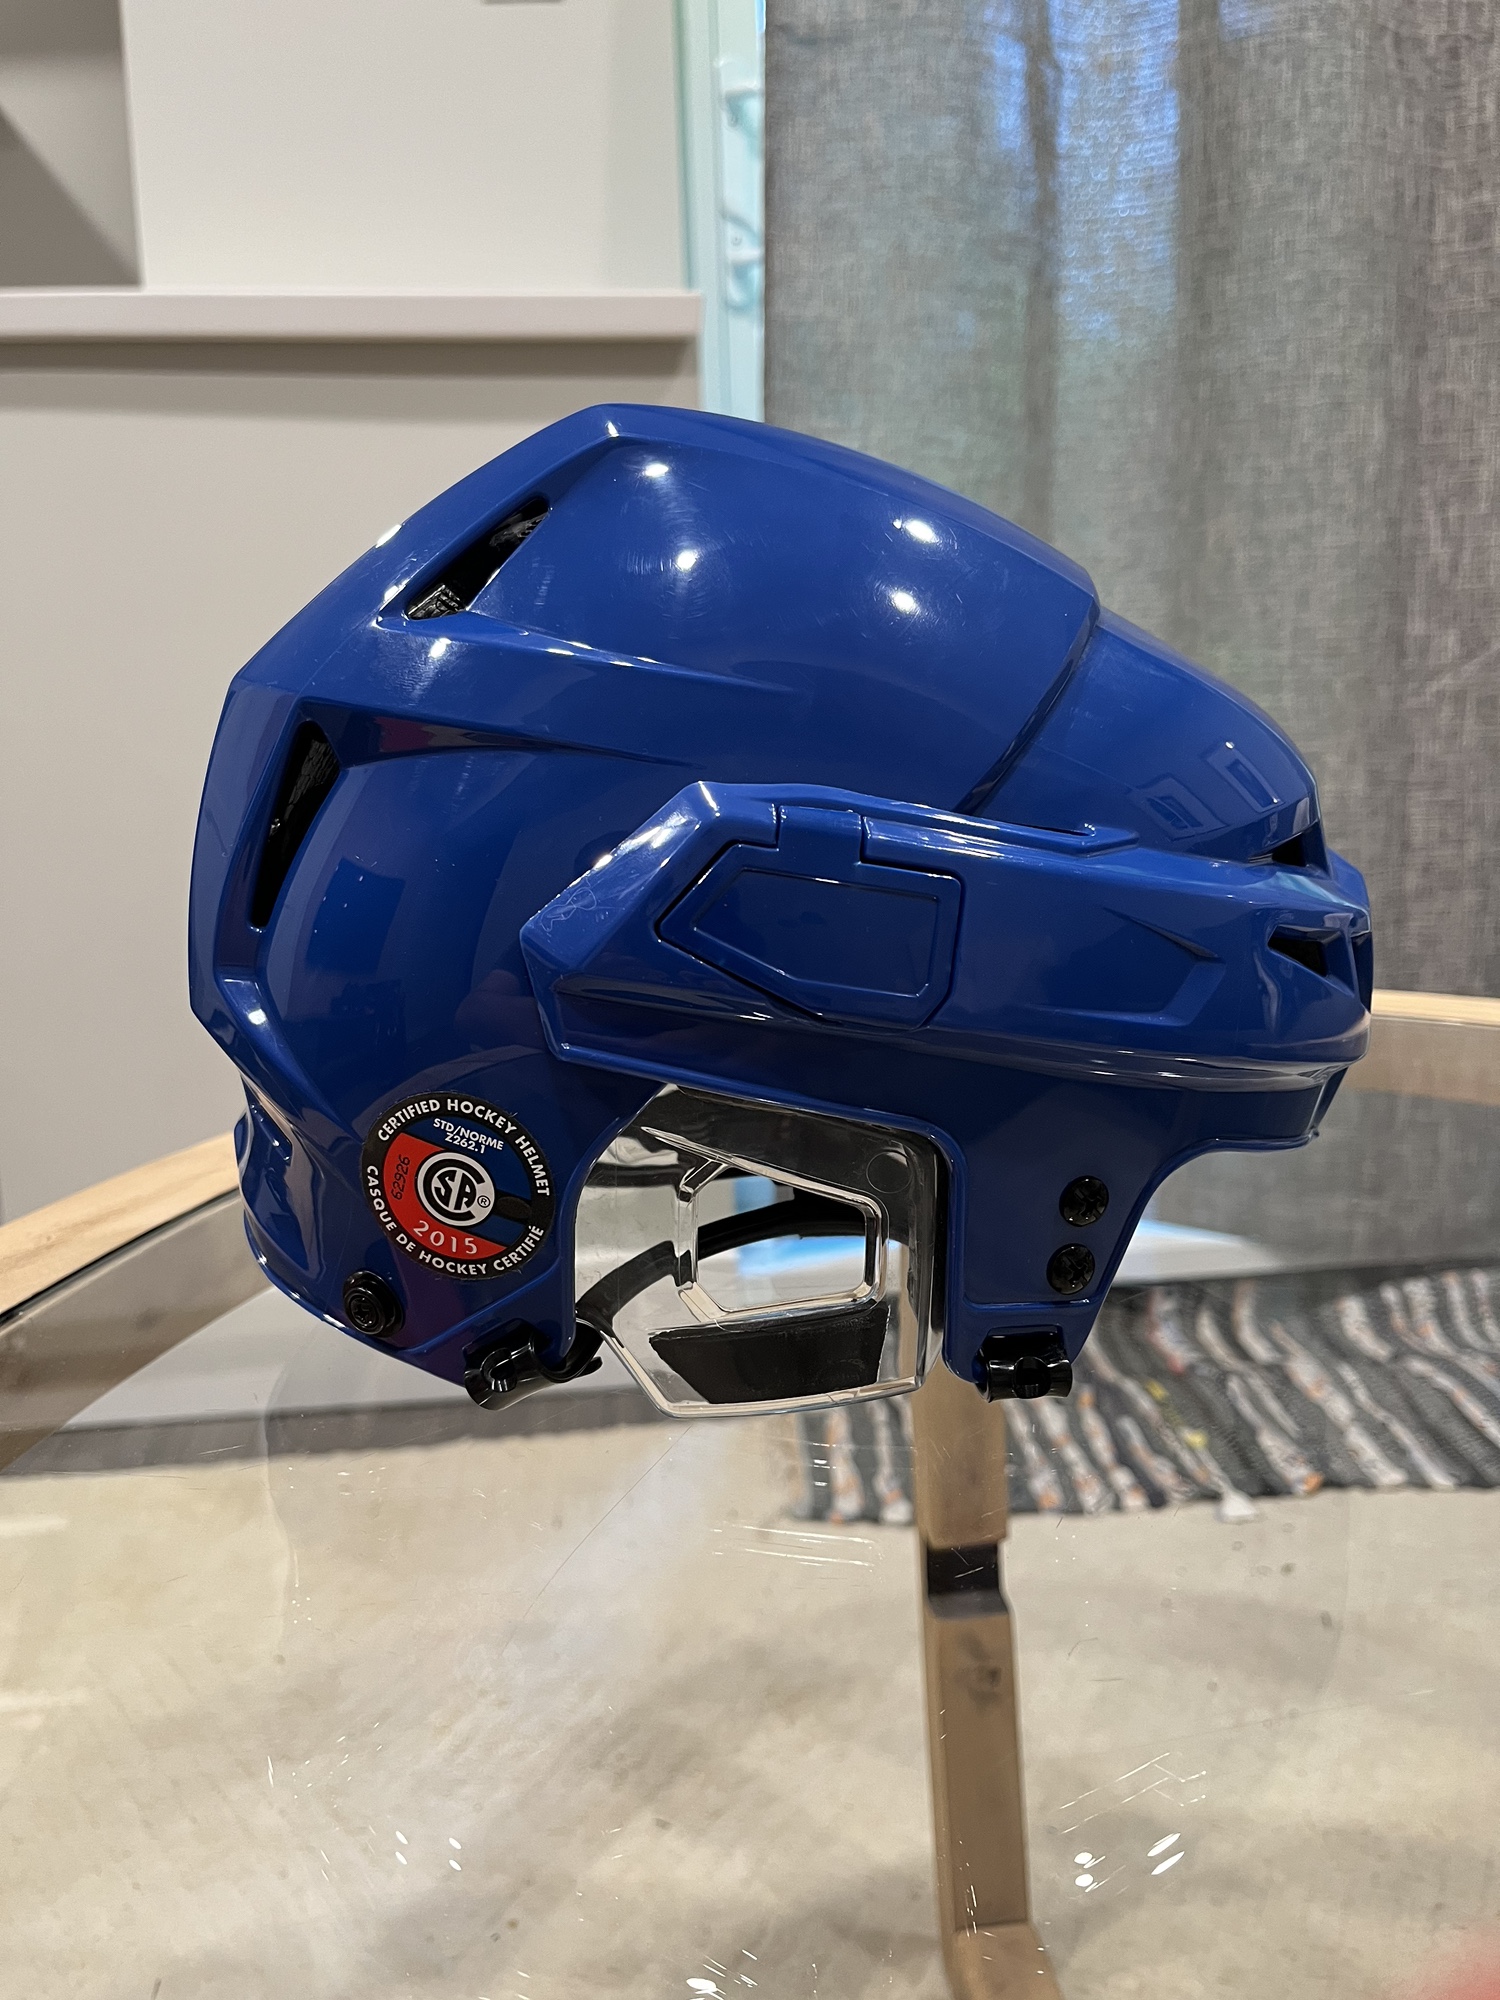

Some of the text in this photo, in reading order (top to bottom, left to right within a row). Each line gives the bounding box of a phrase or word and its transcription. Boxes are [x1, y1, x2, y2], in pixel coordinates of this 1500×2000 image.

[378, 1099, 550, 1196] CERTIFIED HOCKEY HELMET
[433, 1118, 505, 1150] STD/NORME
[444, 1132, 486, 1154] Z262.1
[391, 1154, 410, 1200] 62926
[366, 1165, 545, 1275] CASQUE DE HOCKEY CERTIFIÉ
[413, 1220, 478, 1255] 2015
